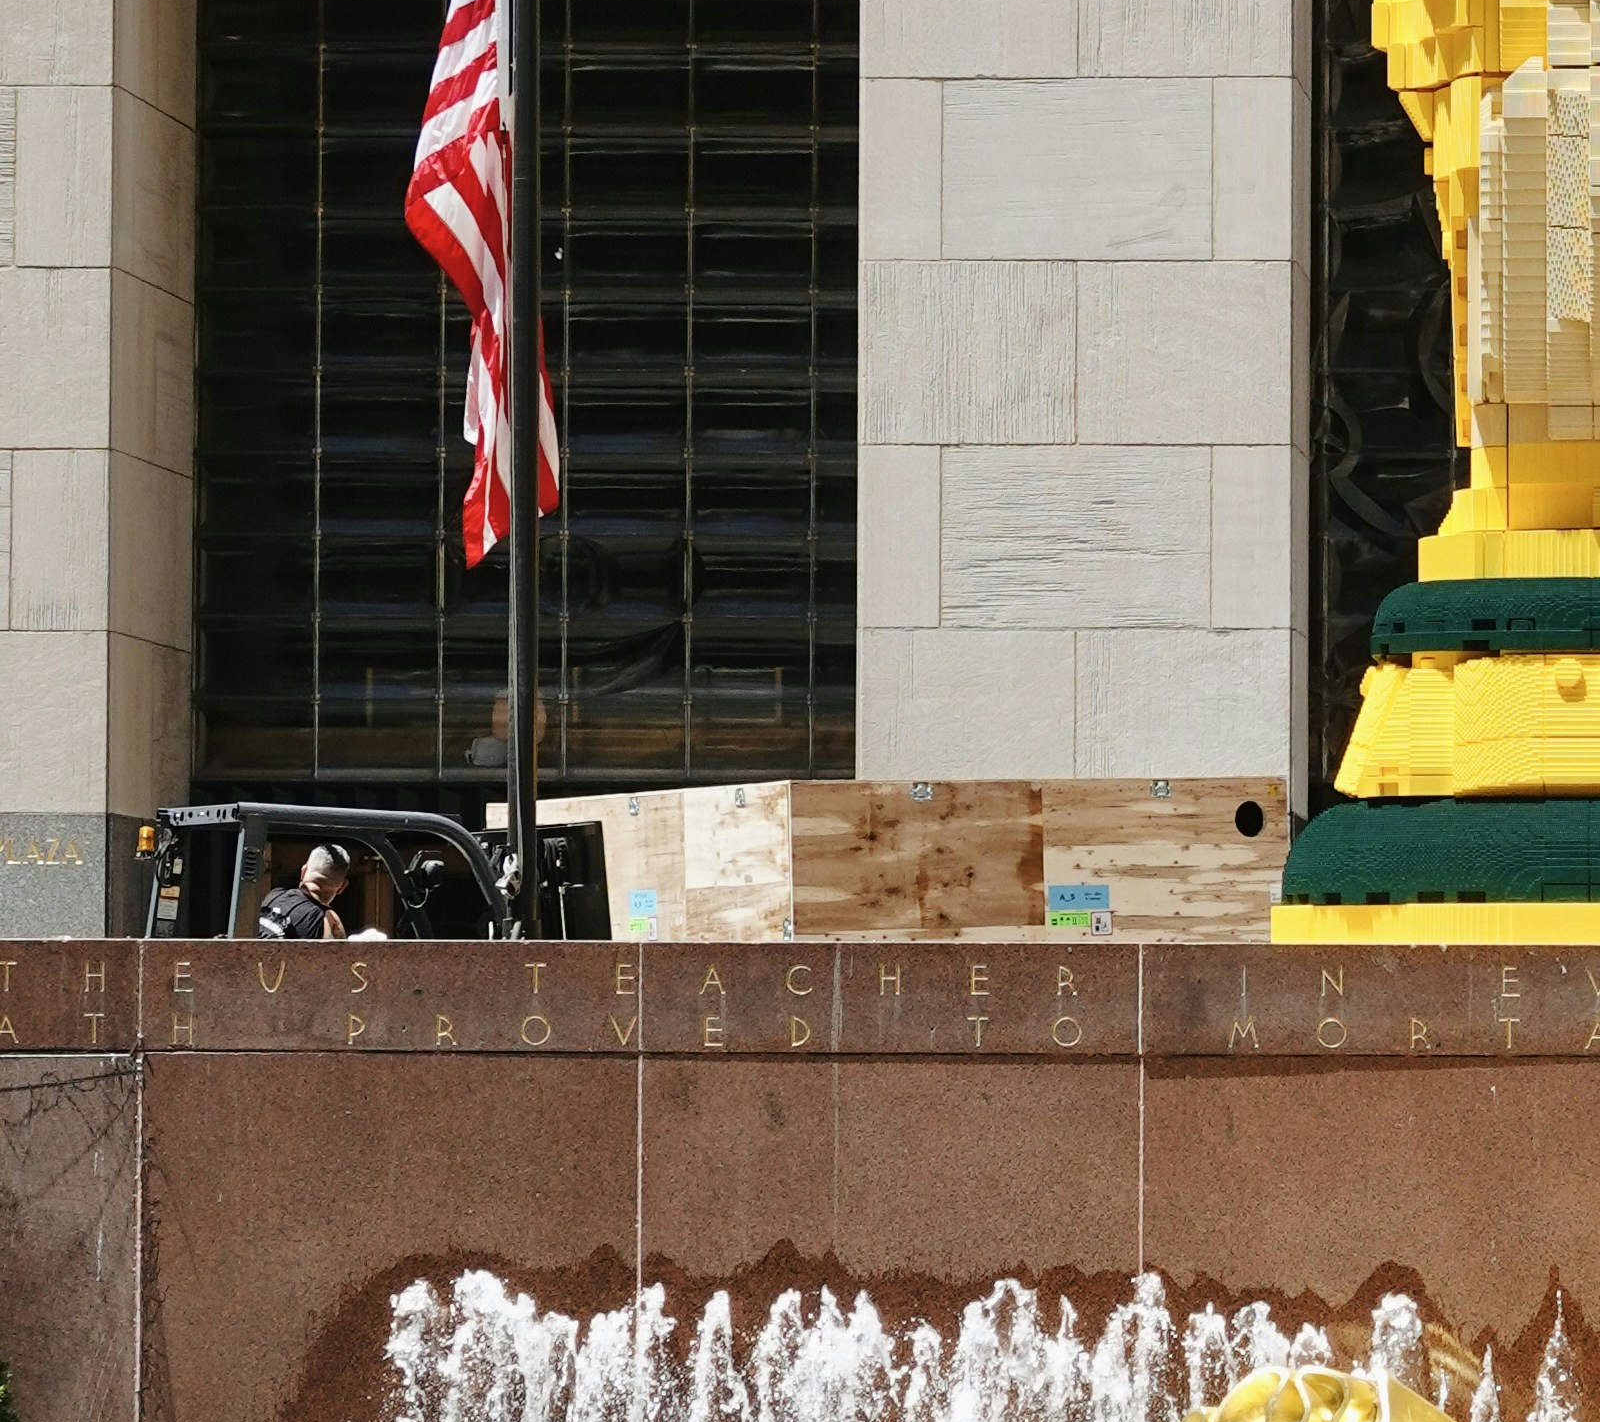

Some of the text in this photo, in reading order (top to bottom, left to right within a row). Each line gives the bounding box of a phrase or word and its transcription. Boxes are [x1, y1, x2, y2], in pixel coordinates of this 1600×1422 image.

[0, 836, 84, 866] LAZA
[0, 961, 370, 995] THEUS
[524, 961, 1079, 997] TEACHER
[1241, 965, 1344, 997] IN
[0, 1014, 194, 1046] ATH
[346, 1013, 811, 1047] PROVED
[965, 1015, 1082, 1048] TO
